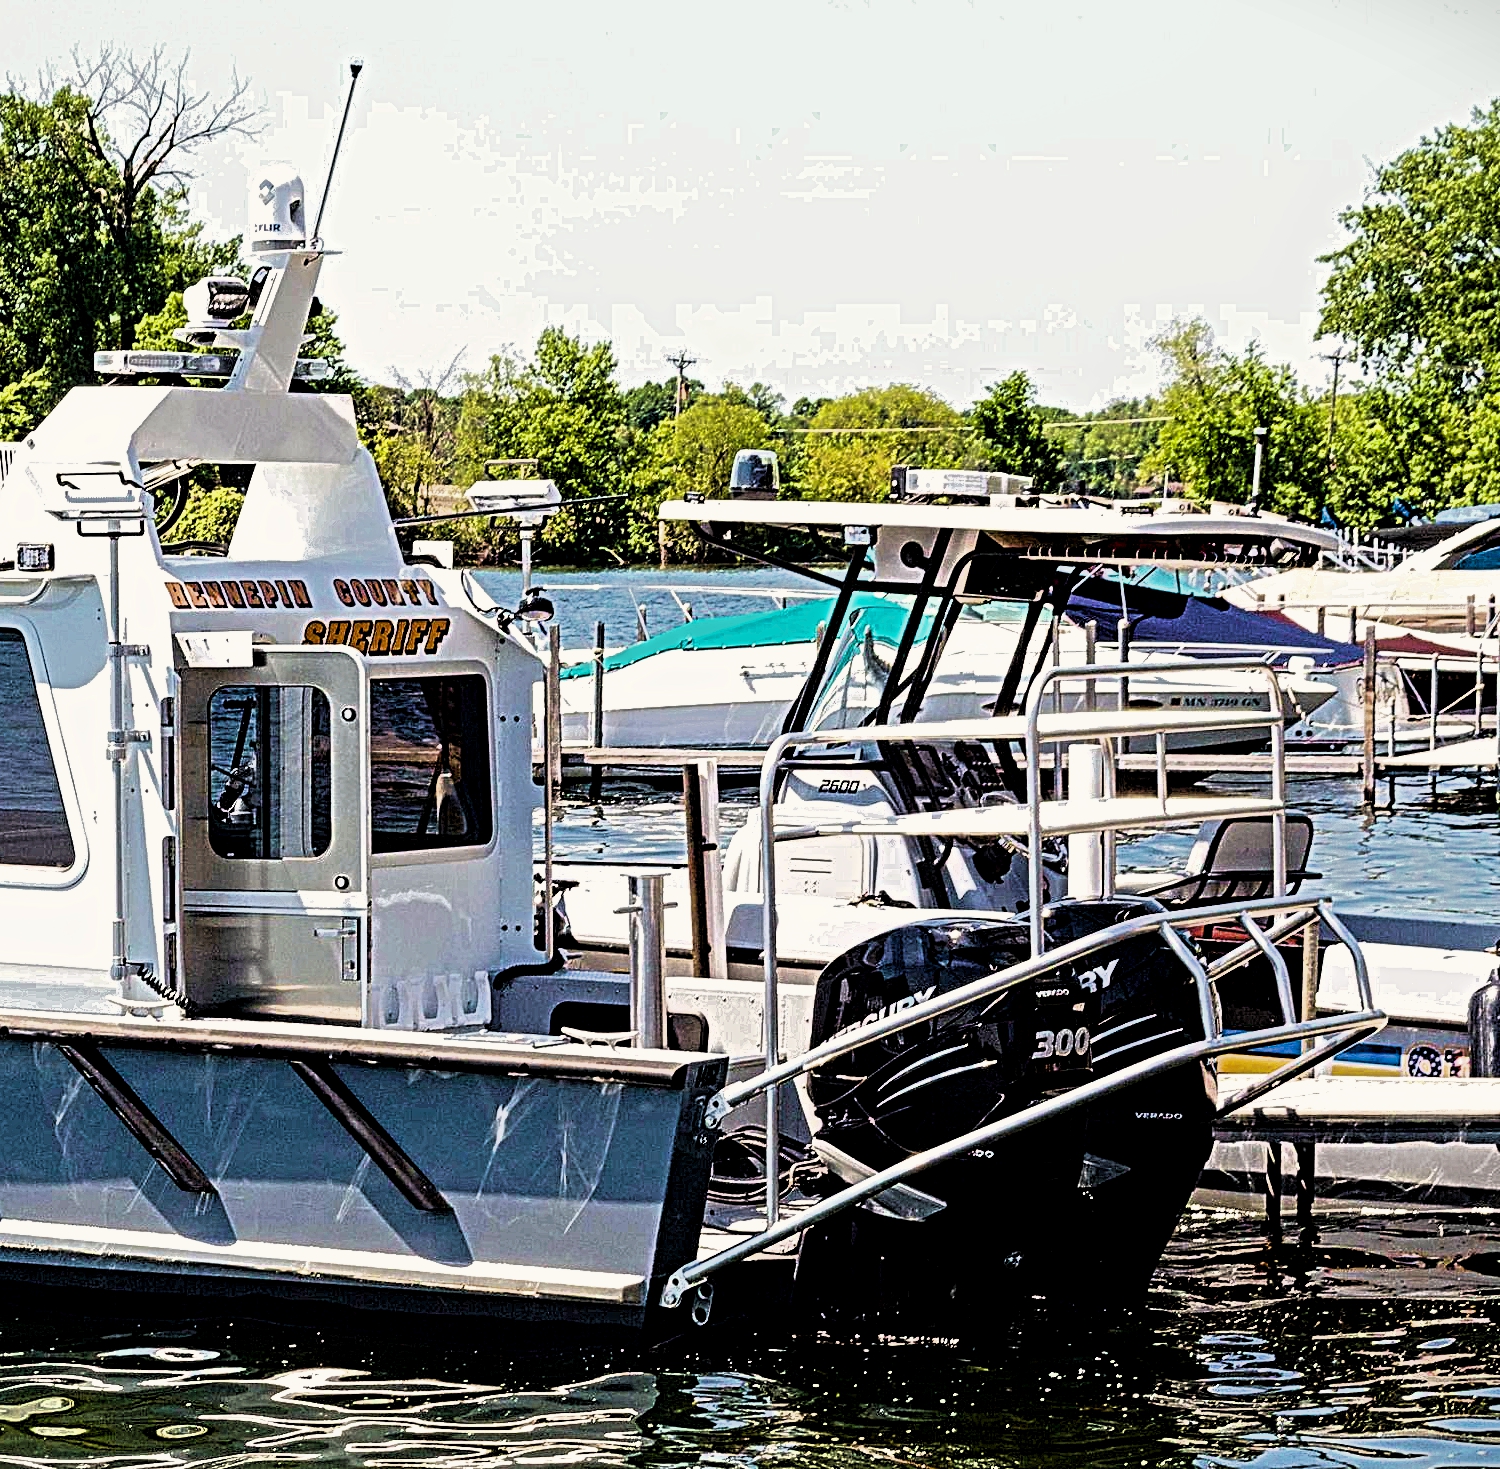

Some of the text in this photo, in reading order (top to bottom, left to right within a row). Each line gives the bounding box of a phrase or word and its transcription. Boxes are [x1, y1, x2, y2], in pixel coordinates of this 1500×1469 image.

[164, 578, 440, 609] HENNEPIN COUNTY
[301, 618, 451, 657] SHERIFF
[1184, 697, 1207, 707] MN
[819, 779, 860, 794] 2600
[1031, 1027, 1091, 1060] 300
[1134, 1111, 1183, 1120] VERADO
